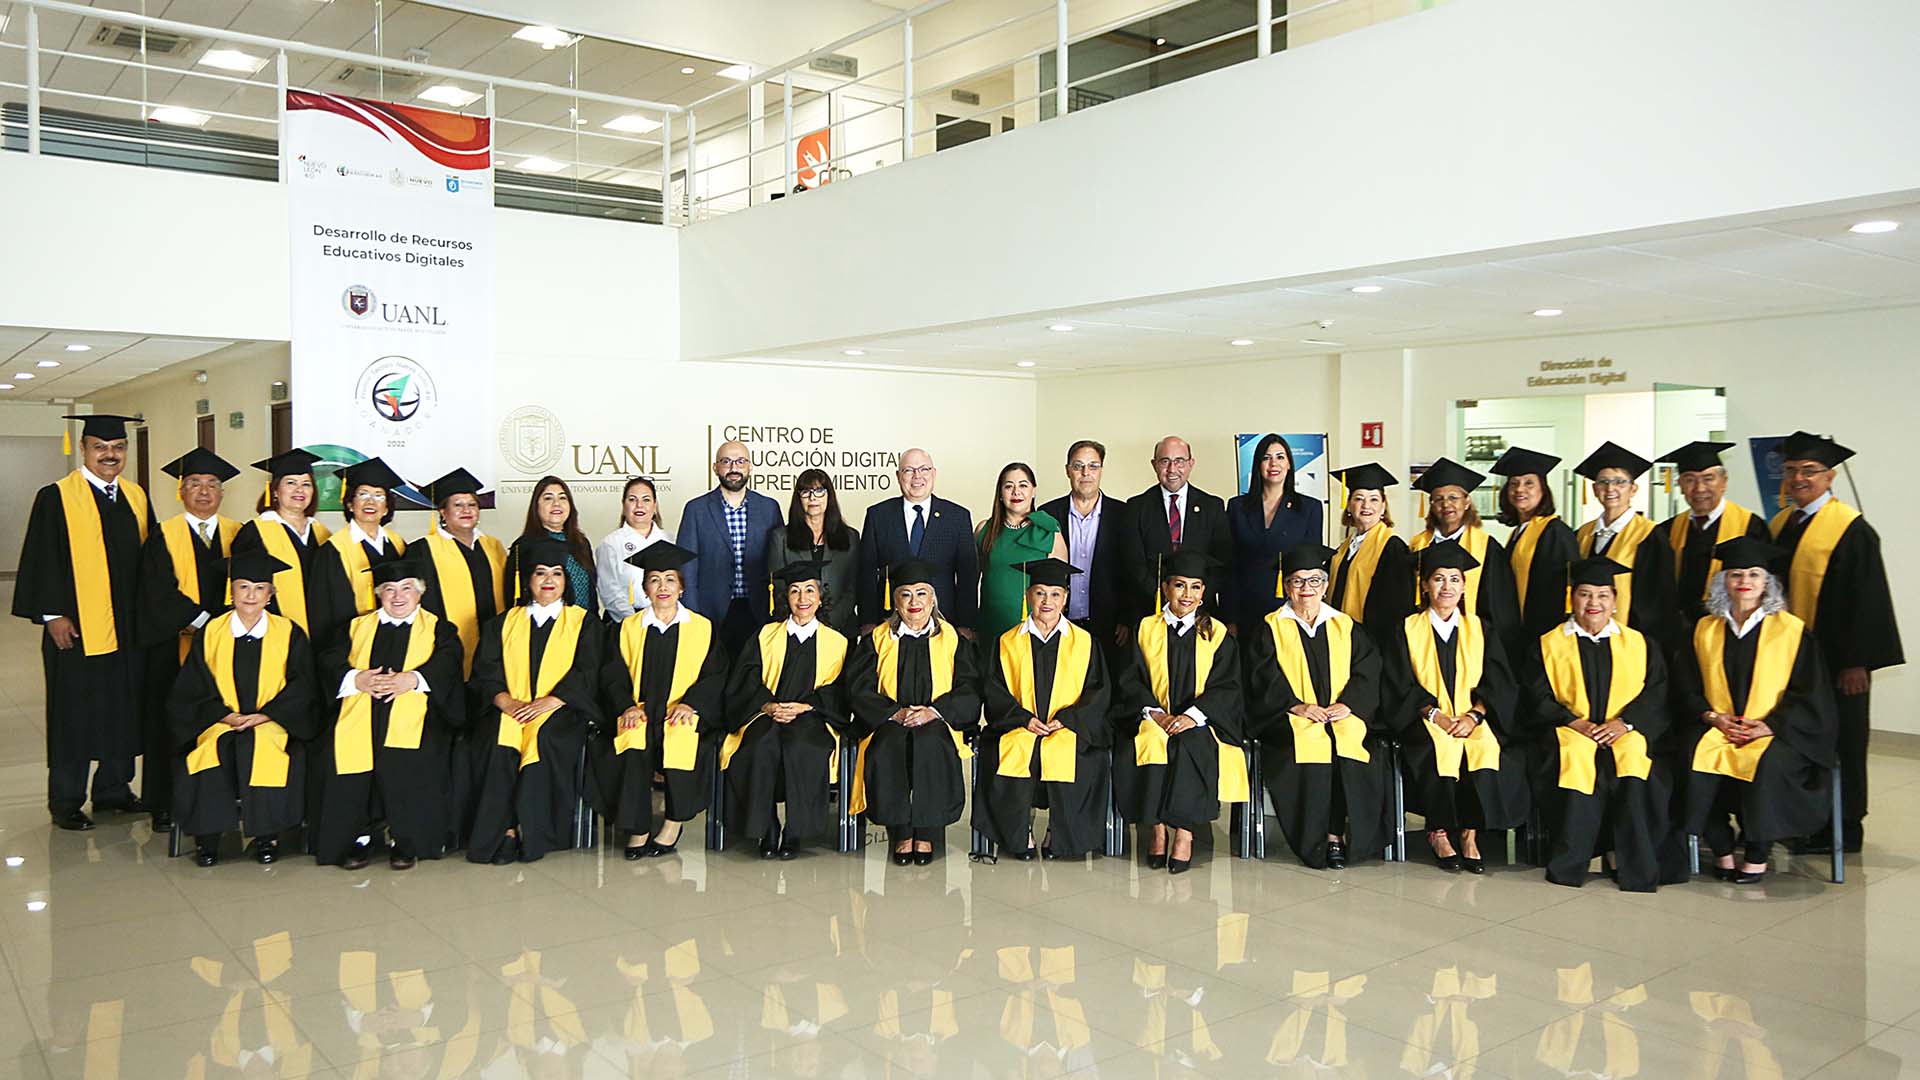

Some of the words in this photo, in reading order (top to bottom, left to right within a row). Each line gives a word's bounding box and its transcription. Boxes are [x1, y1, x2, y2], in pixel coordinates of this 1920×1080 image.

[313, 224, 387, 242] Desarrollo
[390, 231, 408, 244] de
[411, 234, 473, 251] Recursos
[323, 244, 402, 262] Educativos
[405, 252, 465, 268] Digitales
[381, 303, 446, 326] UANL
[1540, 357, 1595, 371] Dirección
[1598, 357, 1612, 367] de
[1526, 373, 1586, 387] Educación
[1588, 371, 1627, 386] Digital
[723, 425, 805, 443] CENTRO
[810, 427, 834, 444] DE
[571, 444, 672, 475] UANL
[752, 447, 837, 467] UCACIÓN
